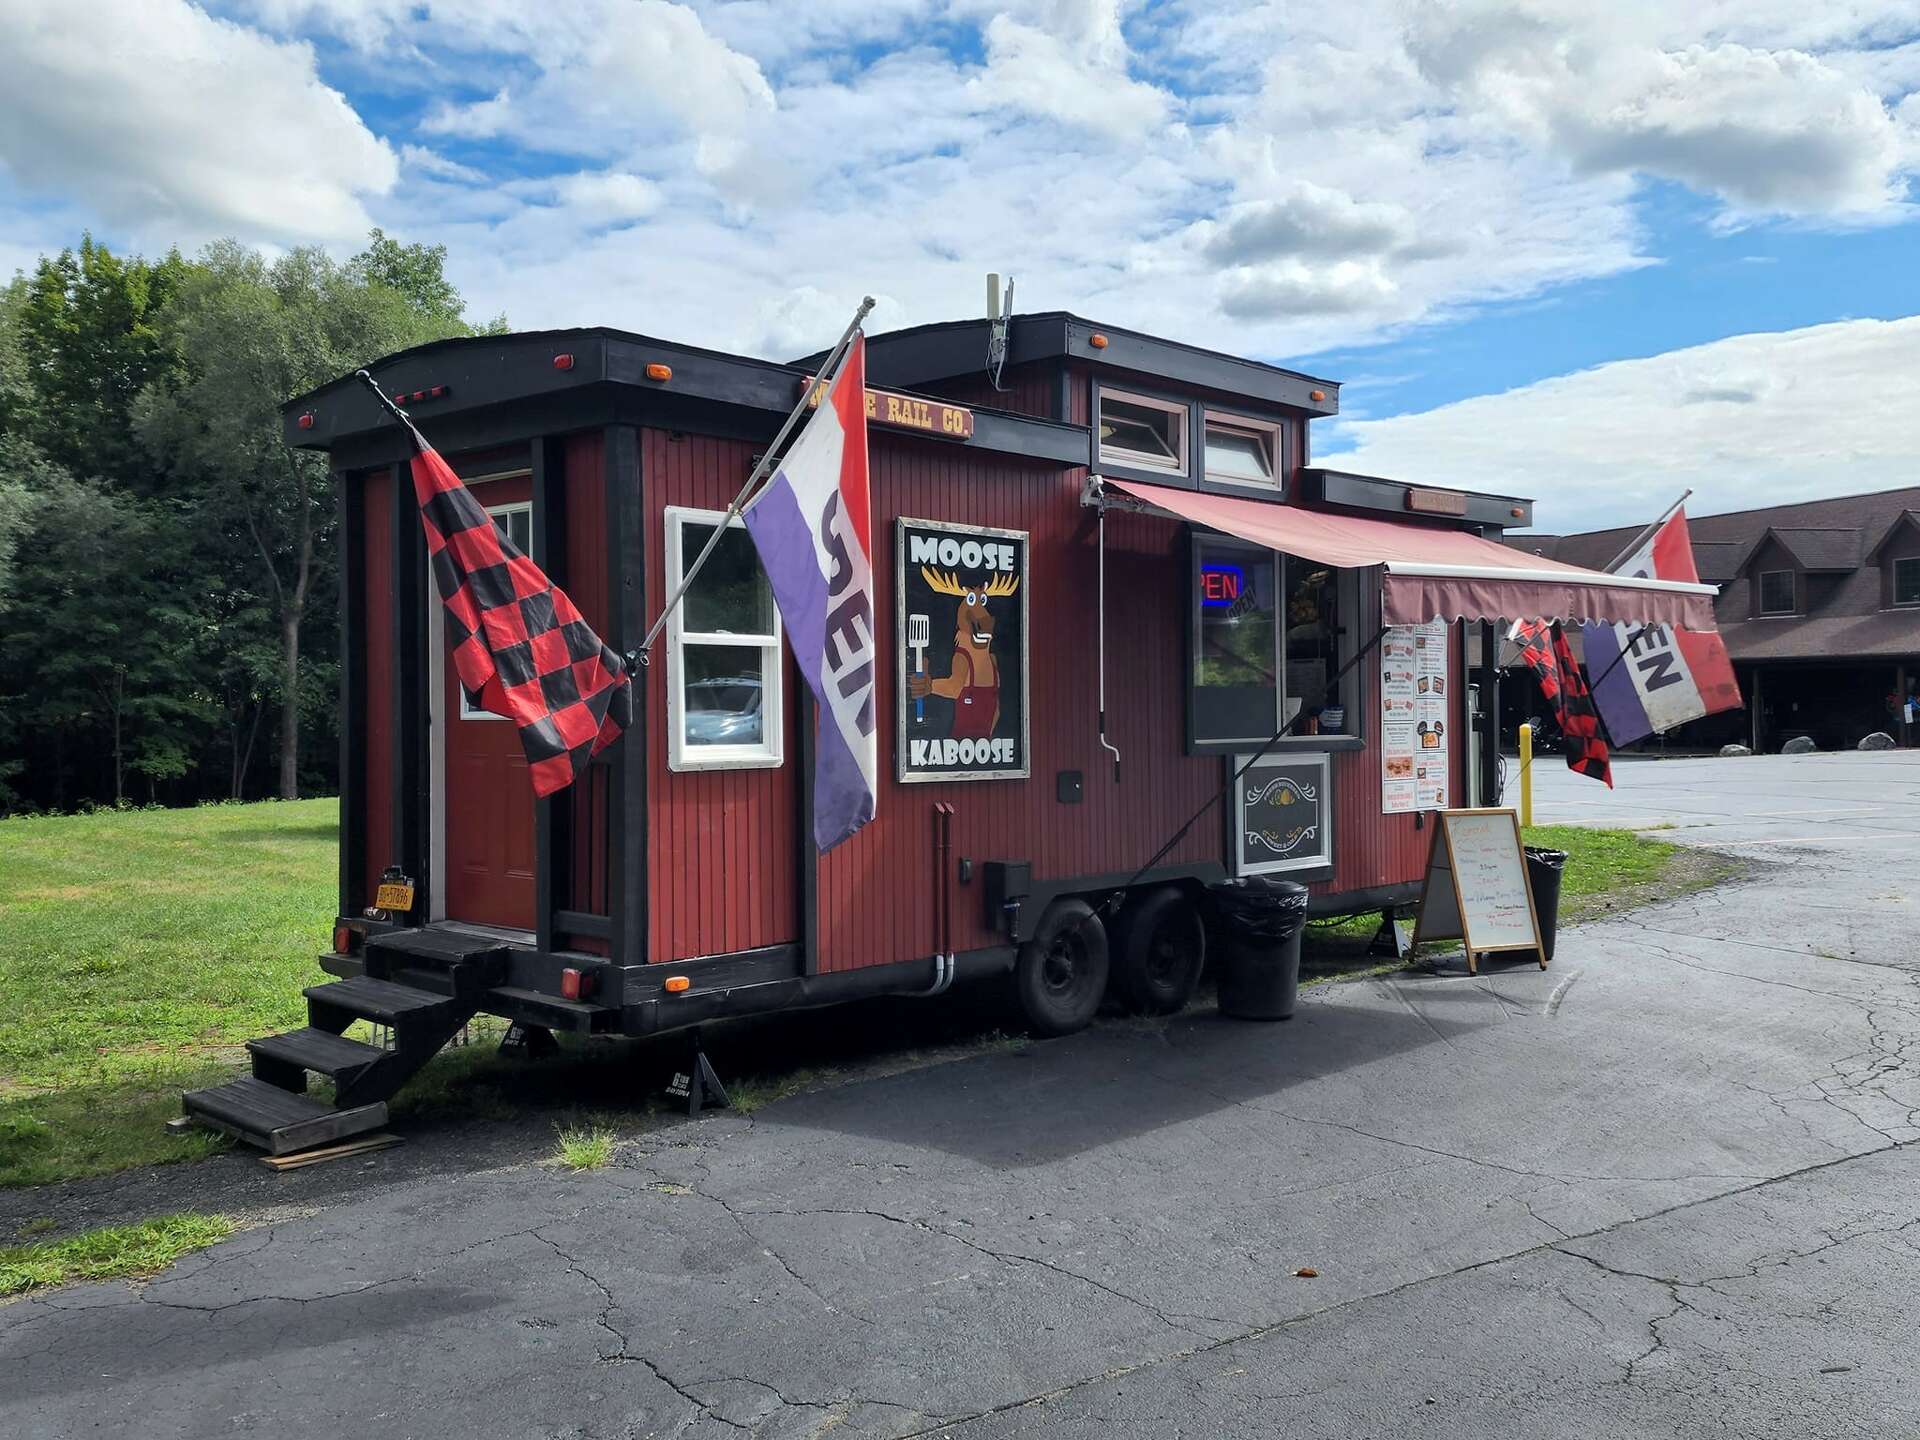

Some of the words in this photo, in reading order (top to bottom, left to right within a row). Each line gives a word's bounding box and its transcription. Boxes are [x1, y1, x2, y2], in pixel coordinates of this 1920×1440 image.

[888, 397, 932, 429] RAIL
[942, 409, 969, 434] CO.
[910, 535, 1015, 572] MOOSE
[1627, 624, 1683, 693] EN
[910, 738, 1014, 767] KABOOSE
